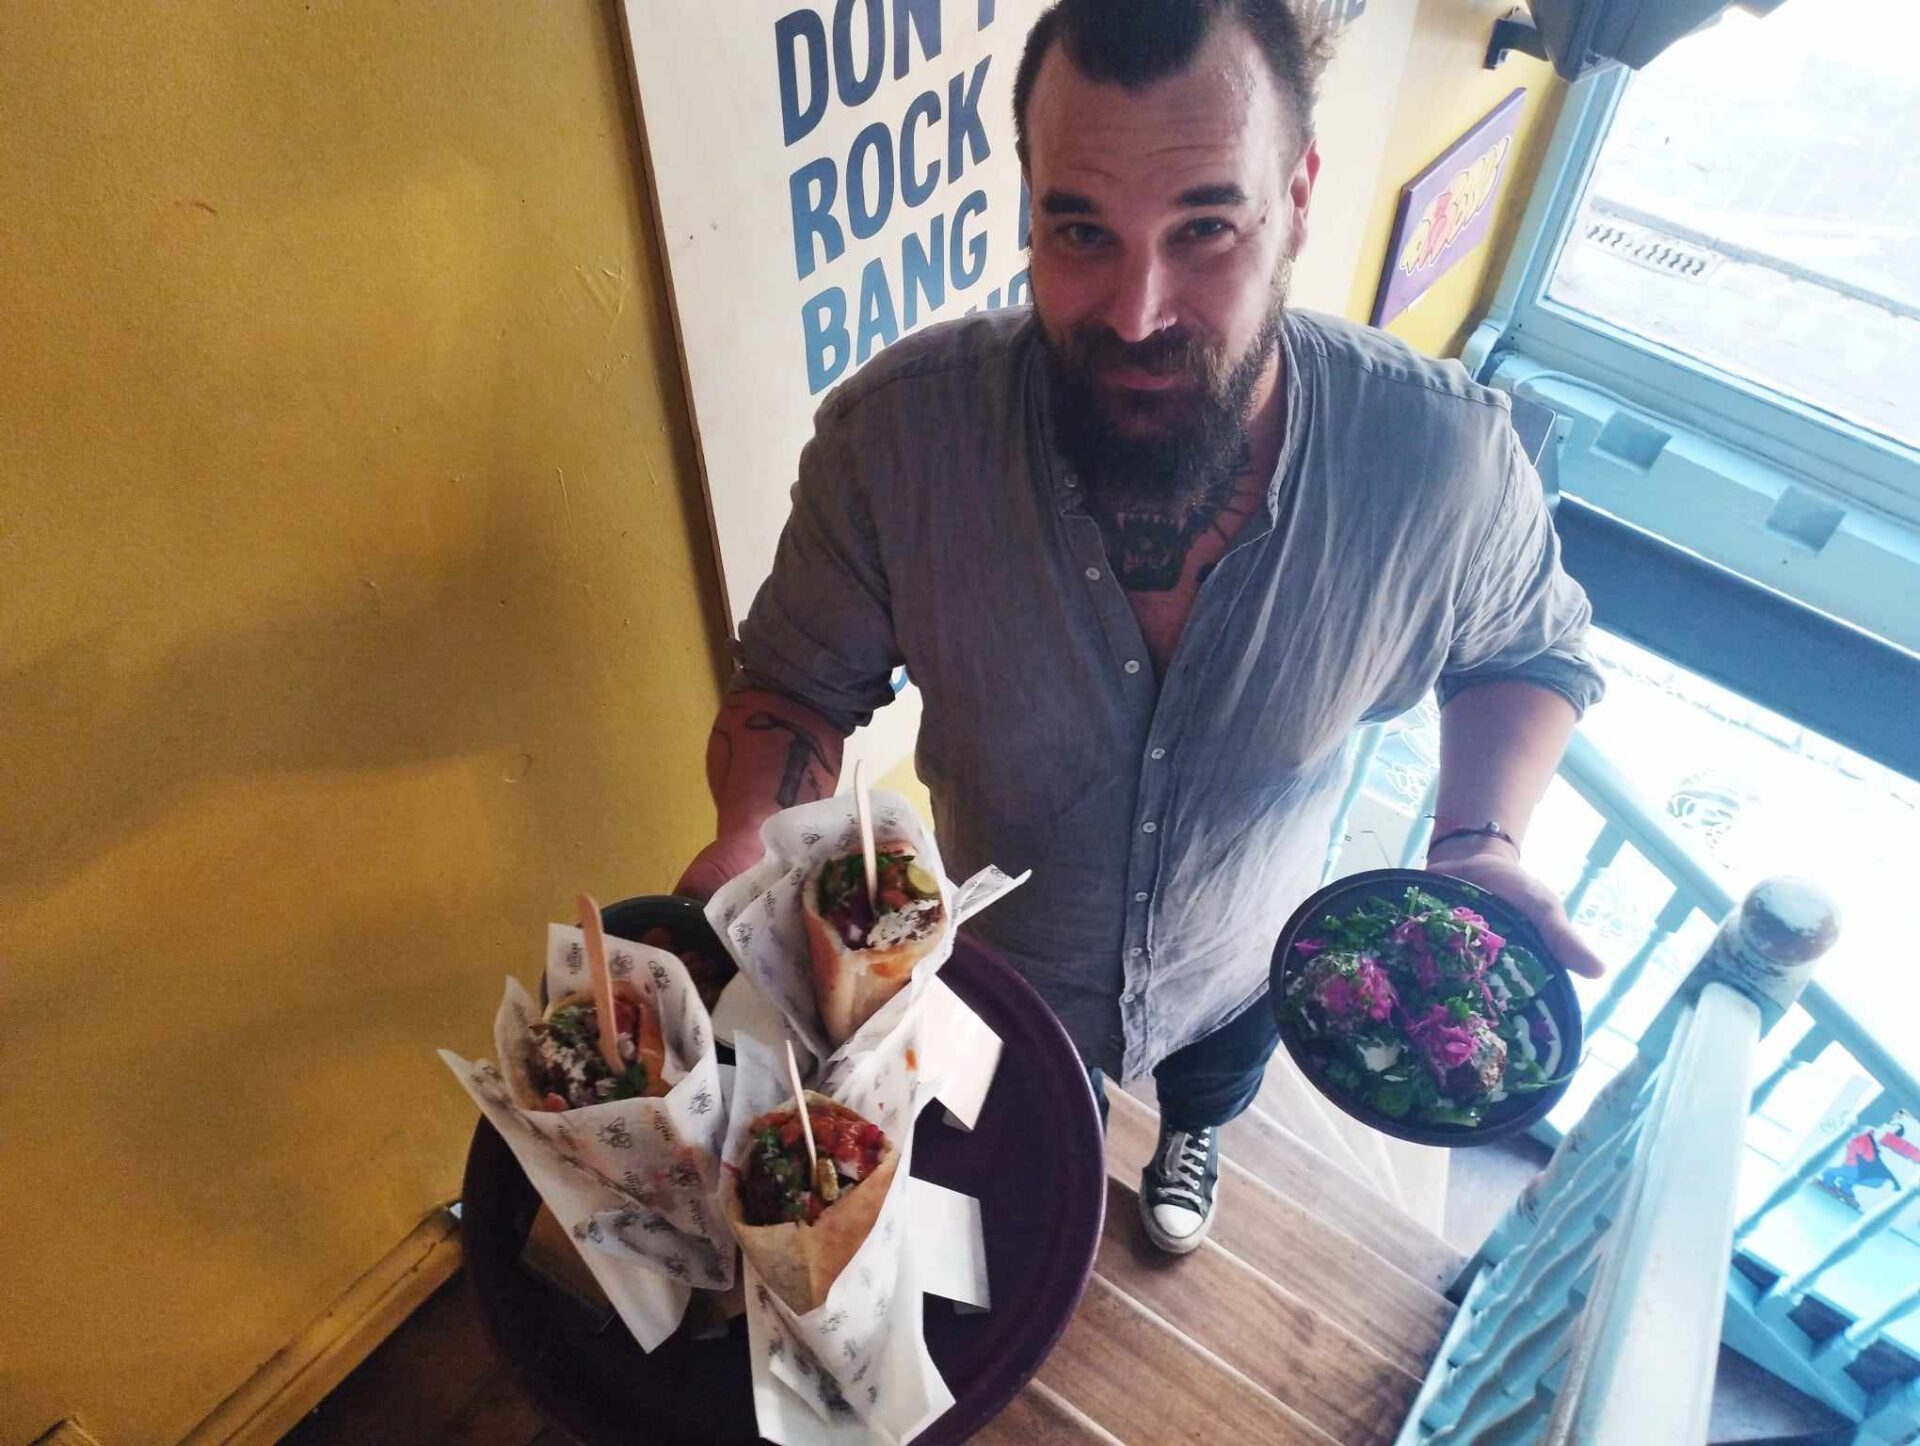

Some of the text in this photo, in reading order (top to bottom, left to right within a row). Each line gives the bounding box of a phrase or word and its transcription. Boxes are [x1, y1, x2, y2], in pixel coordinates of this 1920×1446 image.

[775, 0, 995, 147] DON
[790, 54, 991, 281] ROCK
[801, 189, 988, 395] BANG
